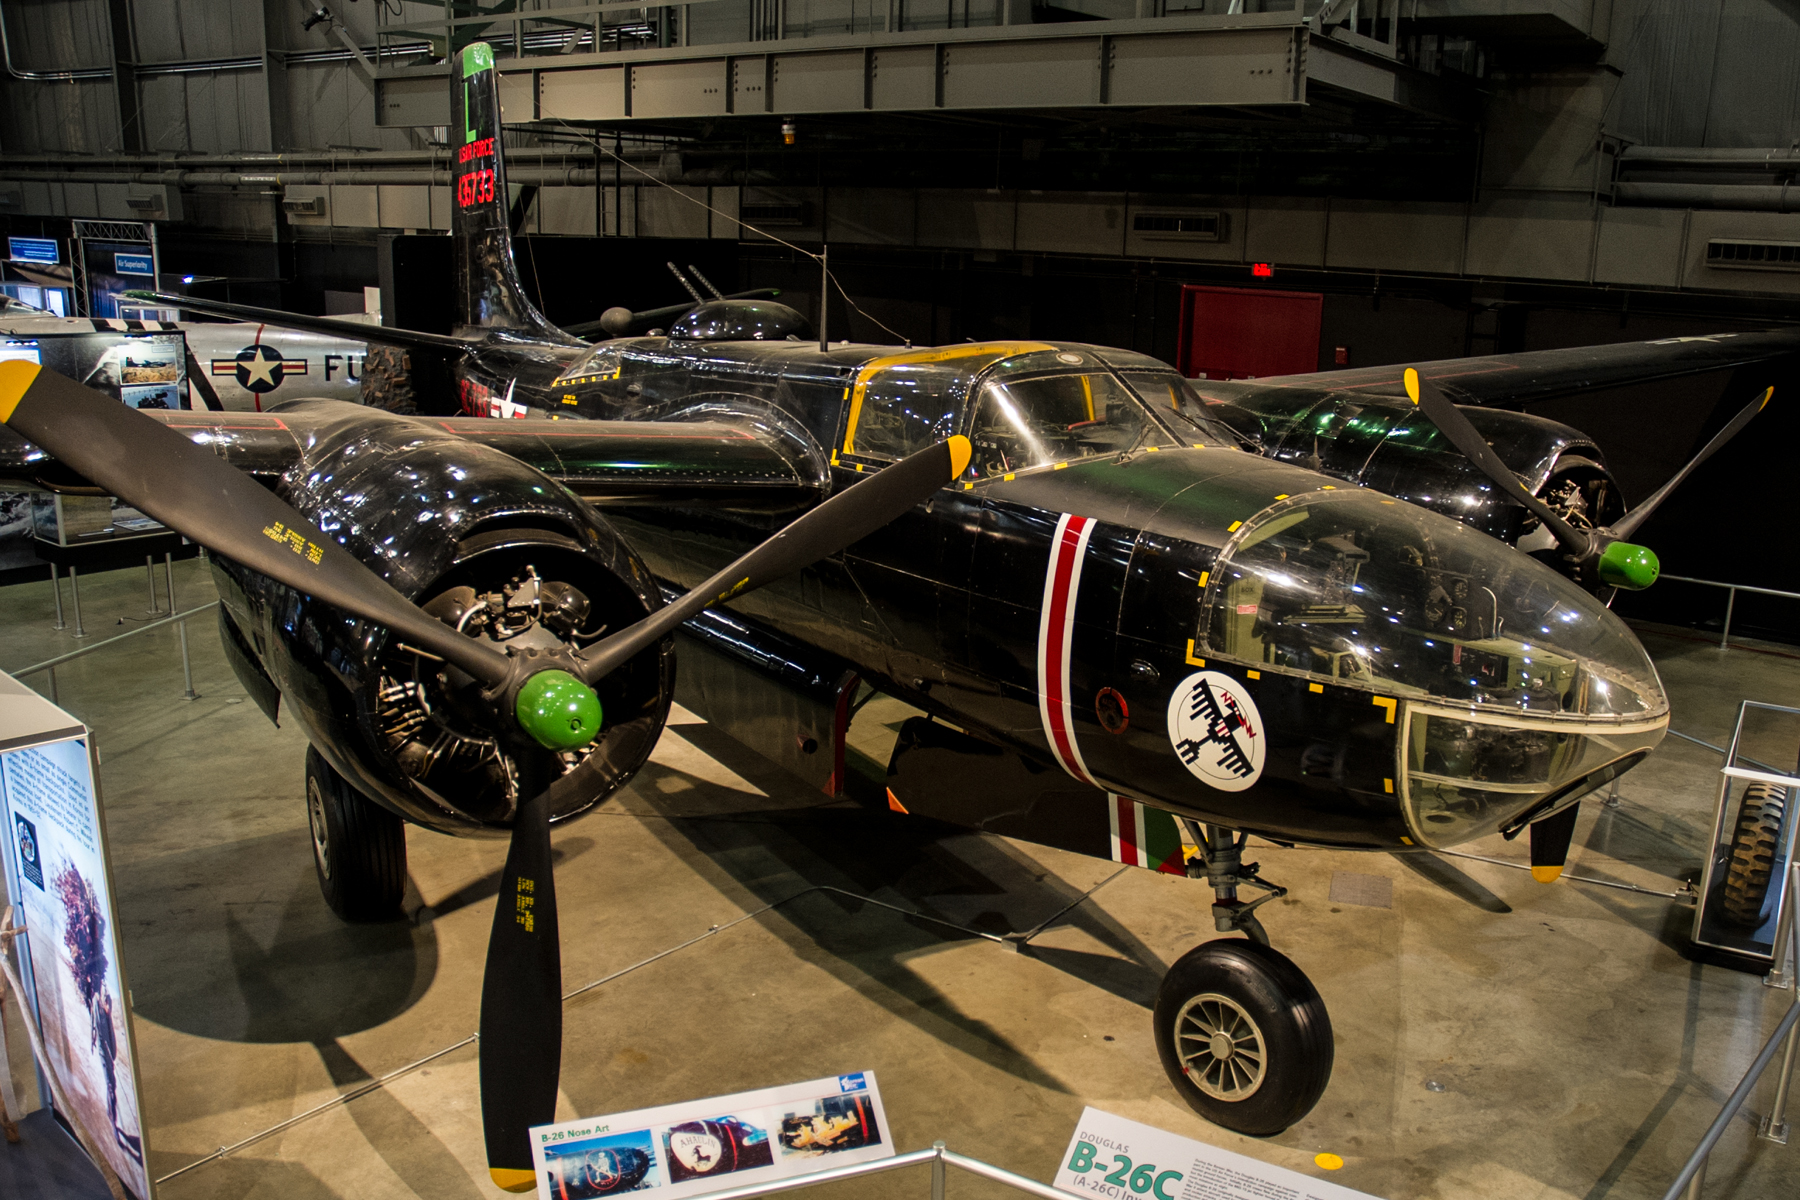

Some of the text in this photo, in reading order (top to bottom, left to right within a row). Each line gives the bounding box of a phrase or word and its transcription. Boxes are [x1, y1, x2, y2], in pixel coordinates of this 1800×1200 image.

[464, 82, 477, 144] L
[473, 138, 495, 158] FORCE
[124, 259, 148, 271] Superiority
[541, 1125, 609, 1142] B-26 Nose Art
[1079, 1131, 1130, 1154] DOUGLAS
[1067, 1140, 1184, 1200] B-26C
[1073, 1174, 1120, 1199] (A-26C)
